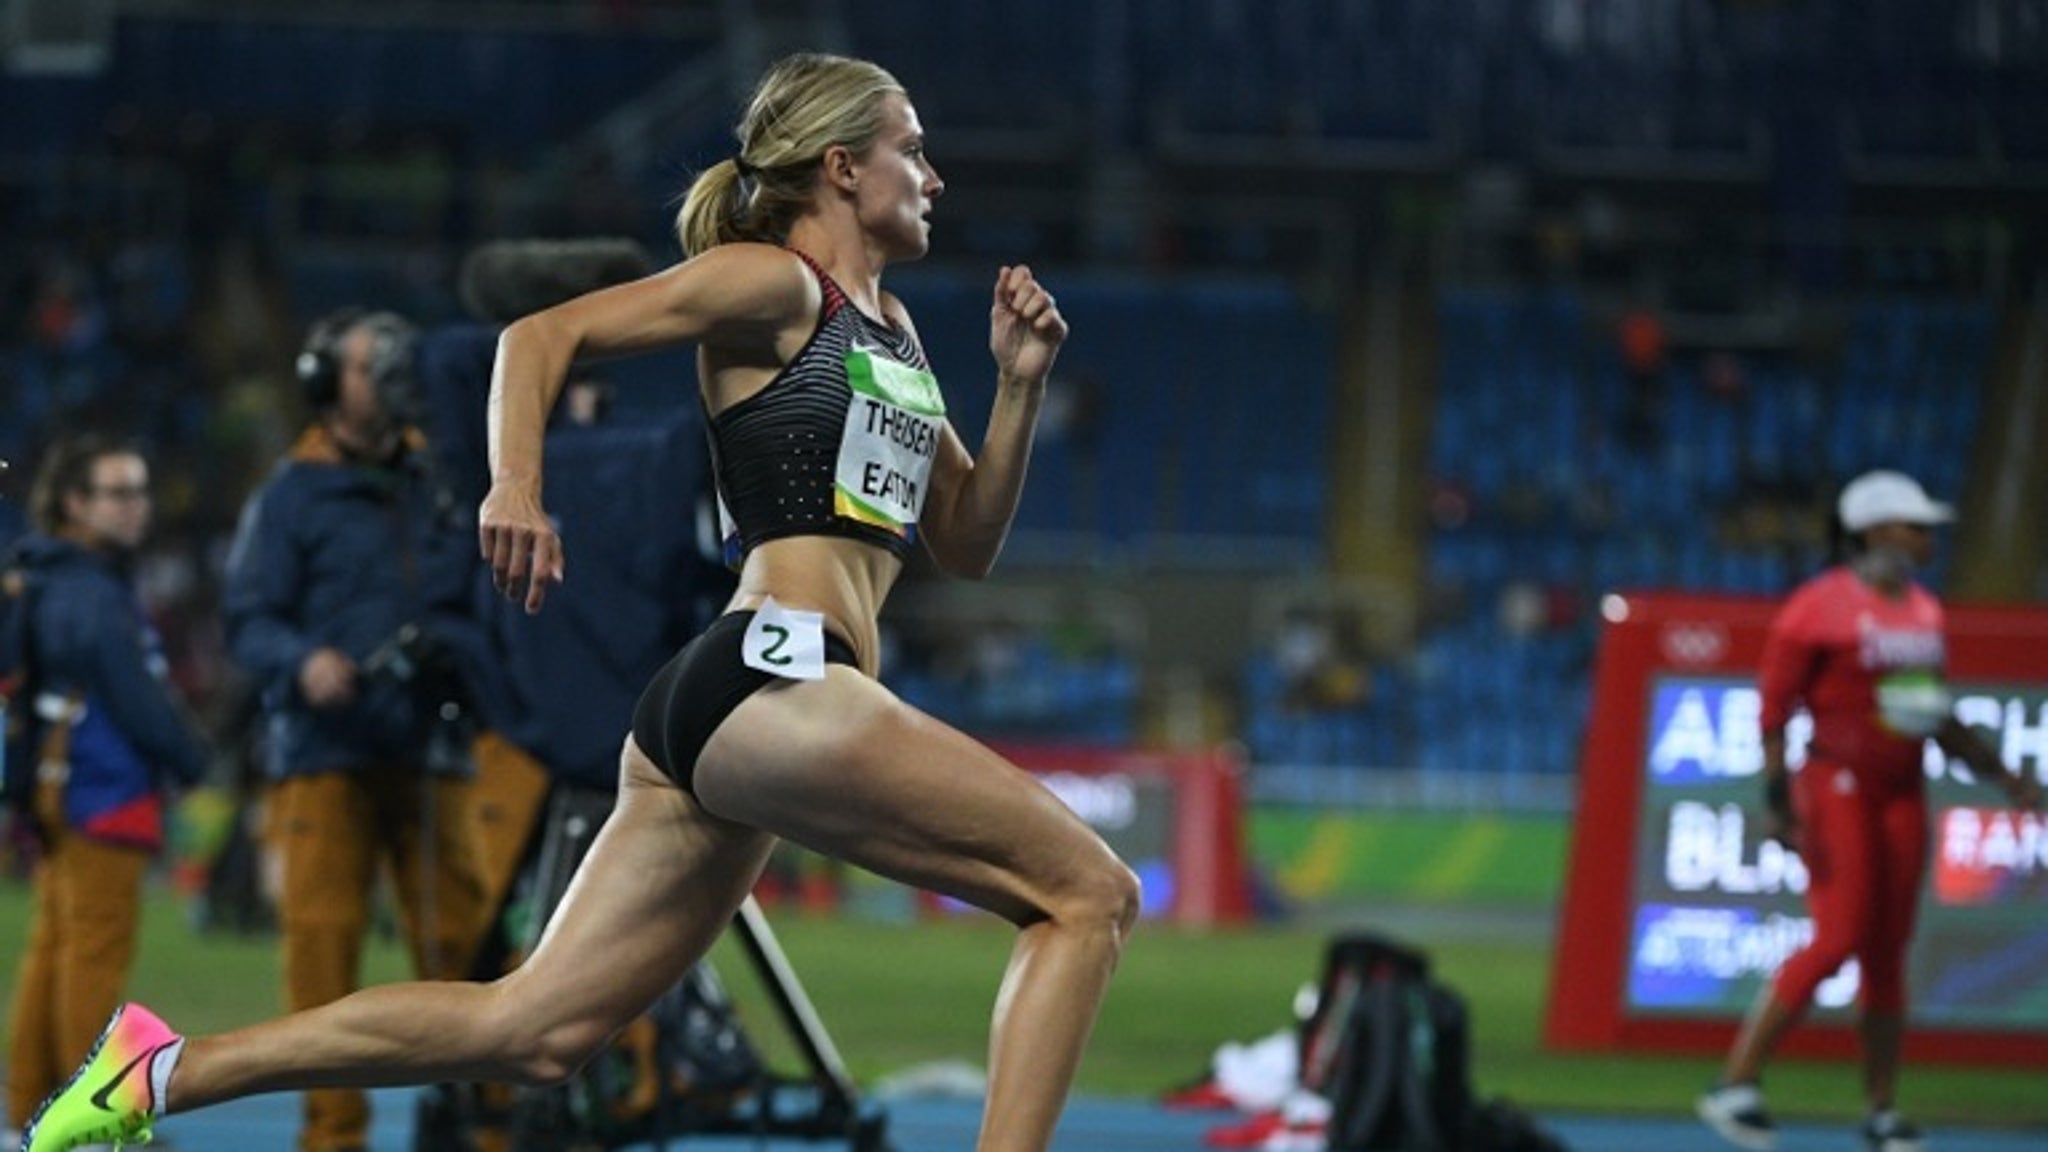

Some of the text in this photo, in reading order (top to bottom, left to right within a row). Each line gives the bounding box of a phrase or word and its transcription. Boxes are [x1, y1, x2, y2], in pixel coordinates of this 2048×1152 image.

[865, 400, 937, 459] THEISEN
[862, 461, 917, 514] EATON
[760, 623, 793, 667] 2
